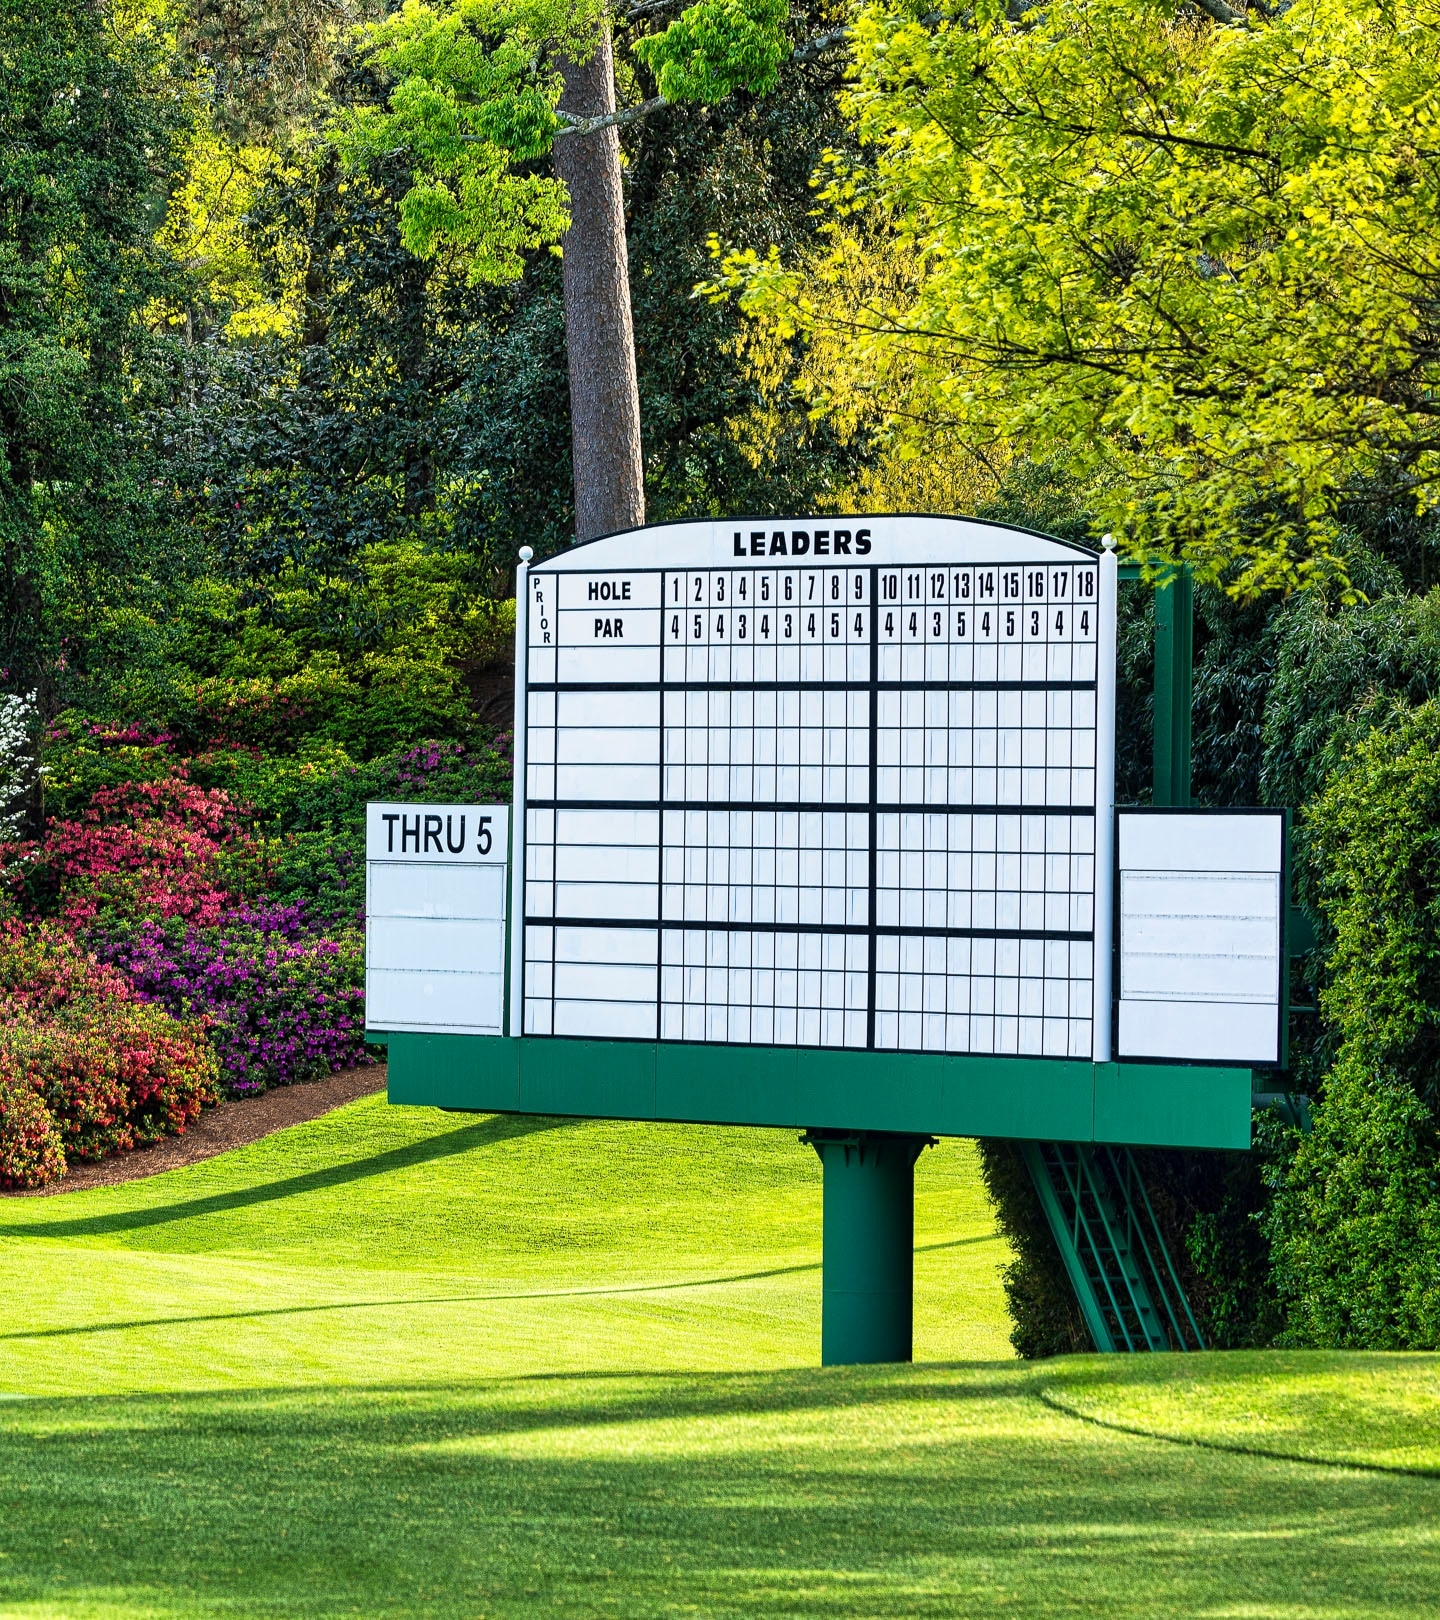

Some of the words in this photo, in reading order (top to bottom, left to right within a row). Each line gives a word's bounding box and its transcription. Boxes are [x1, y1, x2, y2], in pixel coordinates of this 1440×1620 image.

[733, 528, 872, 557] LEADERS
[588, 581, 631, 601] HOLE
[673, 577, 679, 602] 1
[694, 577, 702, 602] 2
[717, 576, 725, 602] 3
[738, 576, 747, 601] 4
[761, 576, 770, 601] 5
[784, 575, 793, 601] 6
[808, 575, 815, 601] 7
[831, 574, 840, 600] 8
[854, 574, 863, 600] 9
[881, 574, 898, 600] 10
[907, 573, 920, 599] 11
[930, 573, 945, 599] 12
[953, 572, 970, 599] 13
[978, 572, 995, 599] 14
[1002, 572, 1019, 598] 15
[1027, 571, 1044, 598] 16
[1052, 571, 1068, 598] 17
[1077, 571, 1094, 597] 18
[533, 577, 551, 644] PRIOR
[594, 618, 624, 638] PAR
[671, 614, 680, 640] 4
[693, 614, 702, 639] 5
[716, 614, 725, 639] 4
[738, 614, 747, 639] 3
[760, 614, 770, 639] 4
[784, 613, 792, 639] 3
[807, 612, 816, 638] 4
[831, 612, 840, 638] 5
[853, 612, 864, 638] 4
[884, 612, 894, 638] 4
[908, 611, 918, 637] 4
[933, 611, 941, 637] 3
[957, 611, 966, 637] 5
[981, 611, 991, 637] 4
[1006, 610, 1015, 637] 5
[1030, 610, 1039, 636] 3
[1055, 610, 1064, 636] 4
[1080, 610, 1090, 636] 4
[381, 813, 466, 854] THRU
[476, 815, 493, 856] 5
